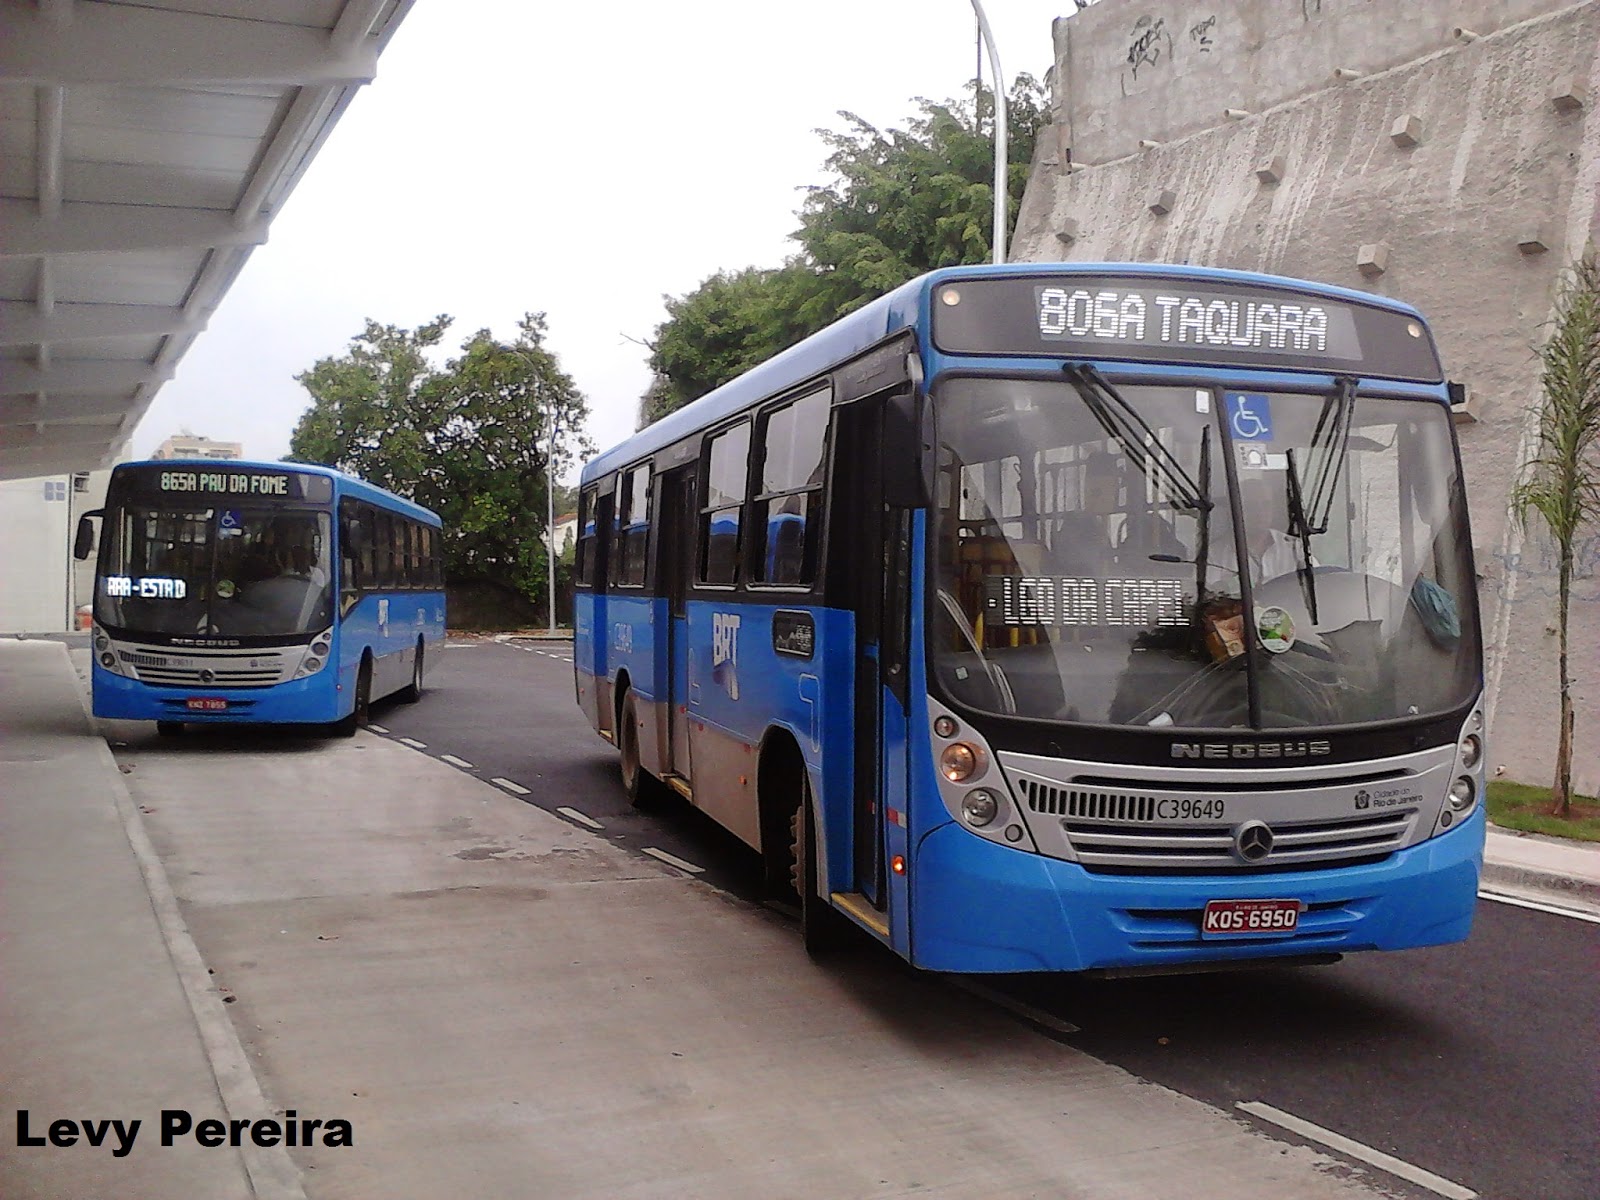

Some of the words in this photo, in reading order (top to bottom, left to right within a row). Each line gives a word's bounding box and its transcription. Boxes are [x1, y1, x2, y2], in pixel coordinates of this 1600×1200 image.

[1154, 295, 1328, 351] TAQUARA
[161, 472, 197, 491] 865A
[200, 473, 227, 493] PAU
[229, 474, 248, 493] DA
[251, 475, 288, 495] FOME
[1062, 578, 1098, 625] DA
[713, 612, 741, 668] BRT
[1170, 740, 1332, 759] NEOBUS
[1157, 799, 1225, 820] C39649
